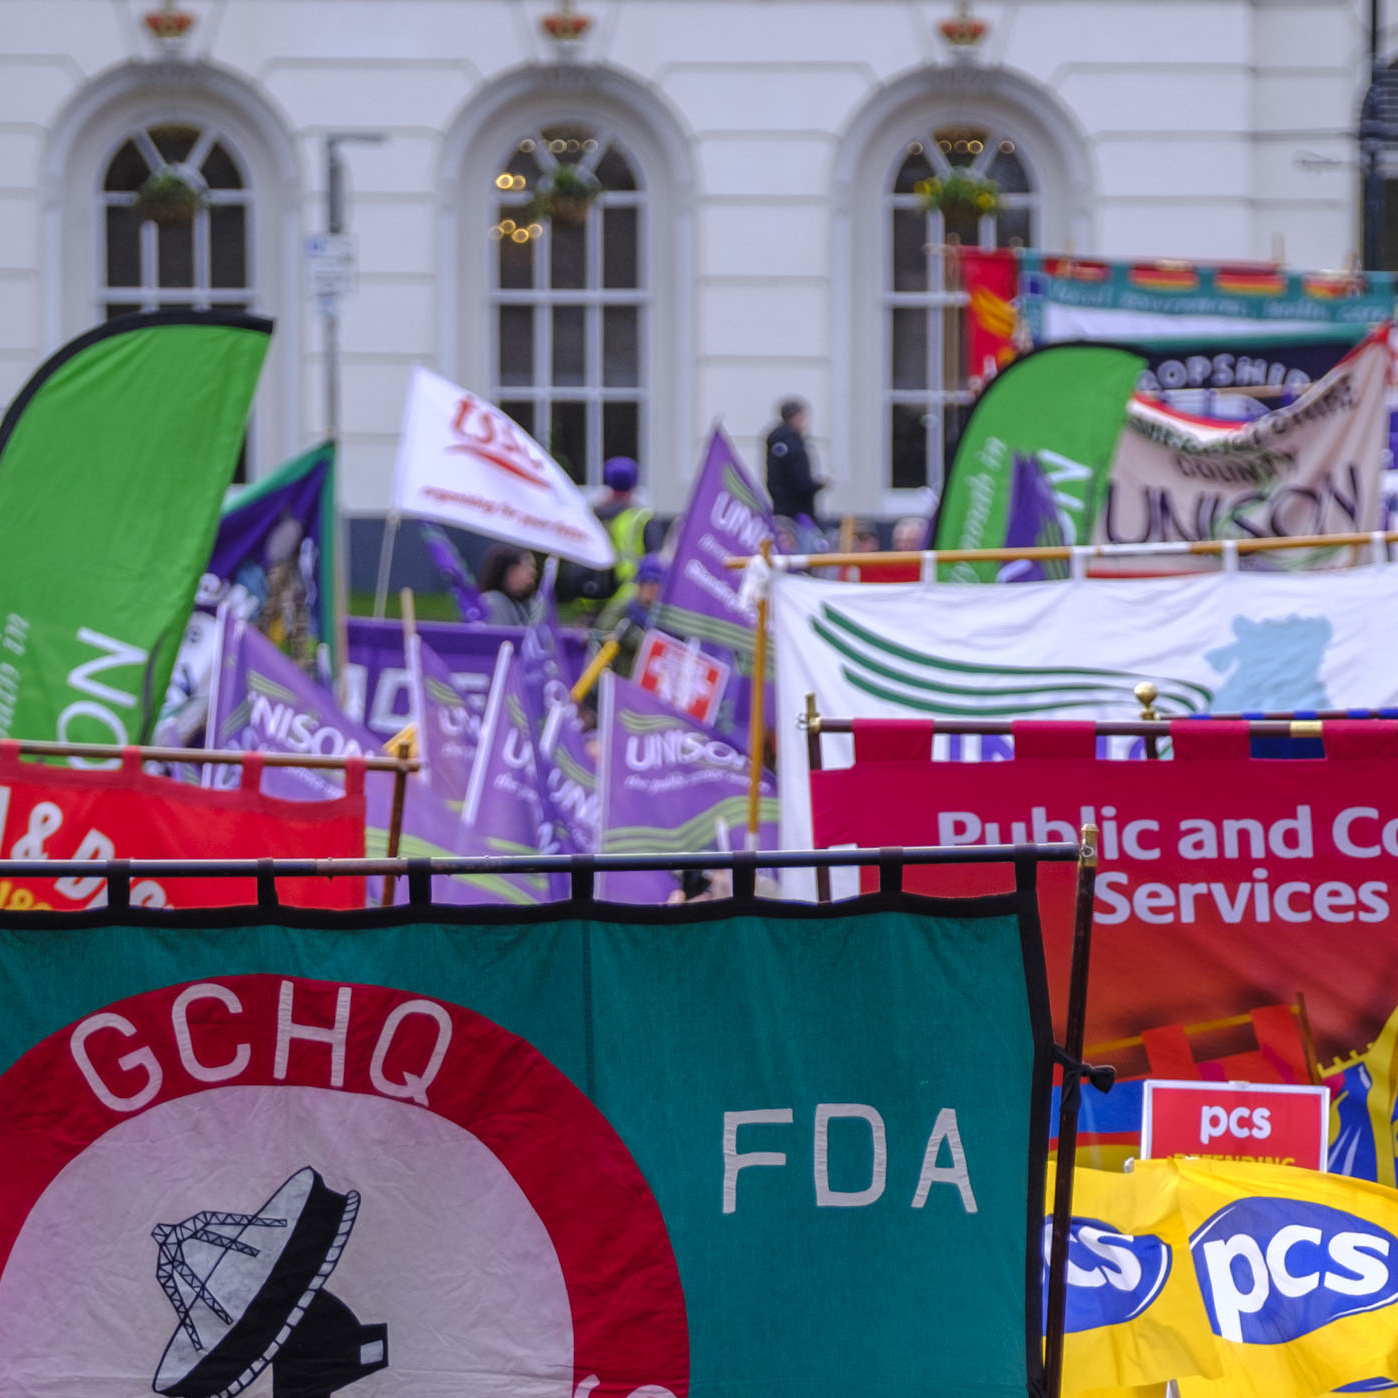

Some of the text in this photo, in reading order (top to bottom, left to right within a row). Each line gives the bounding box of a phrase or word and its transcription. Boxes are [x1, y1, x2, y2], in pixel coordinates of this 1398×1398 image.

[937, 806, 1169, 862] Public
[1179, 804, 1318, 861] and
[1093, 869, 1390, 926] Services
[69, 979, 456, 1116] GCHQ
[722, 1103, 980, 1216] FDA
[1200, 1105, 1272, 1145] pcs
[1202, 1225, 1390, 1343] pcs
